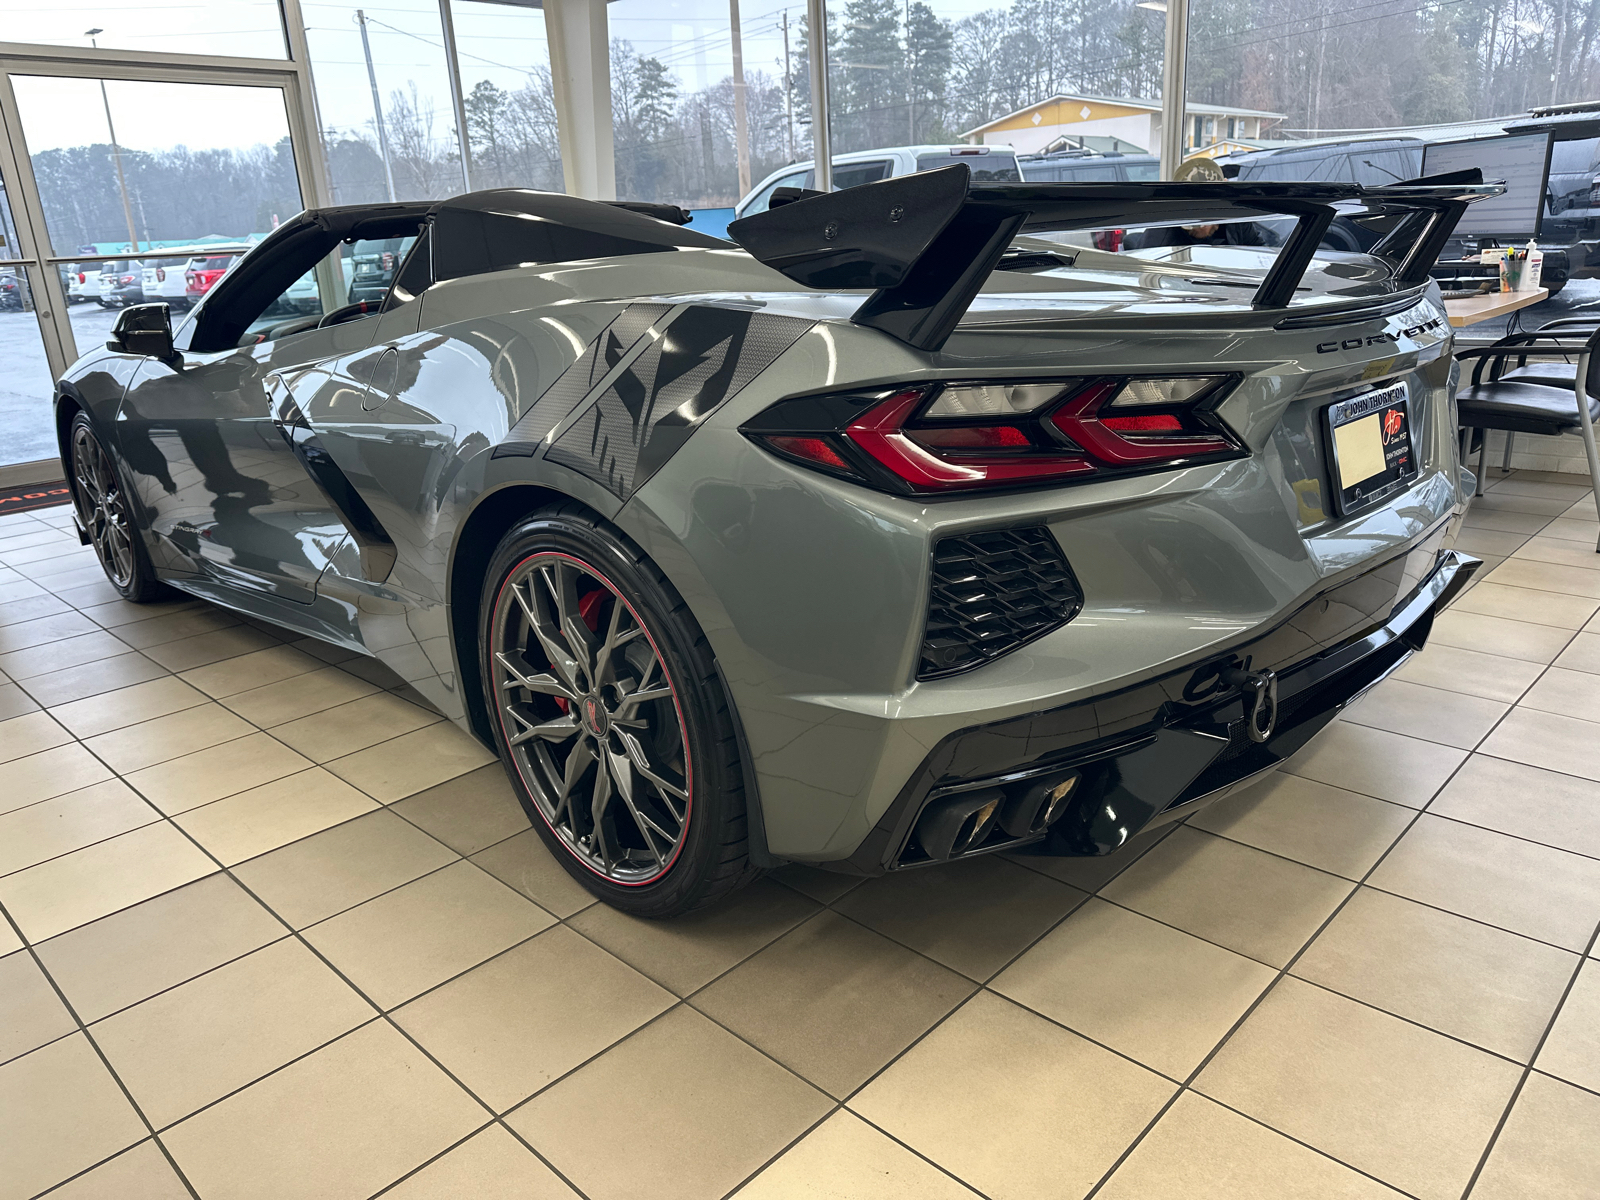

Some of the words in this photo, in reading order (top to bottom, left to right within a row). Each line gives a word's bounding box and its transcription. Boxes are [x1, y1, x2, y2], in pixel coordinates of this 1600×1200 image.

[1316, 317, 1445, 354] CORVETTE
[1350, 398, 1368, 416] JOHN
[170, 524, 203, 534] STINGRAY
